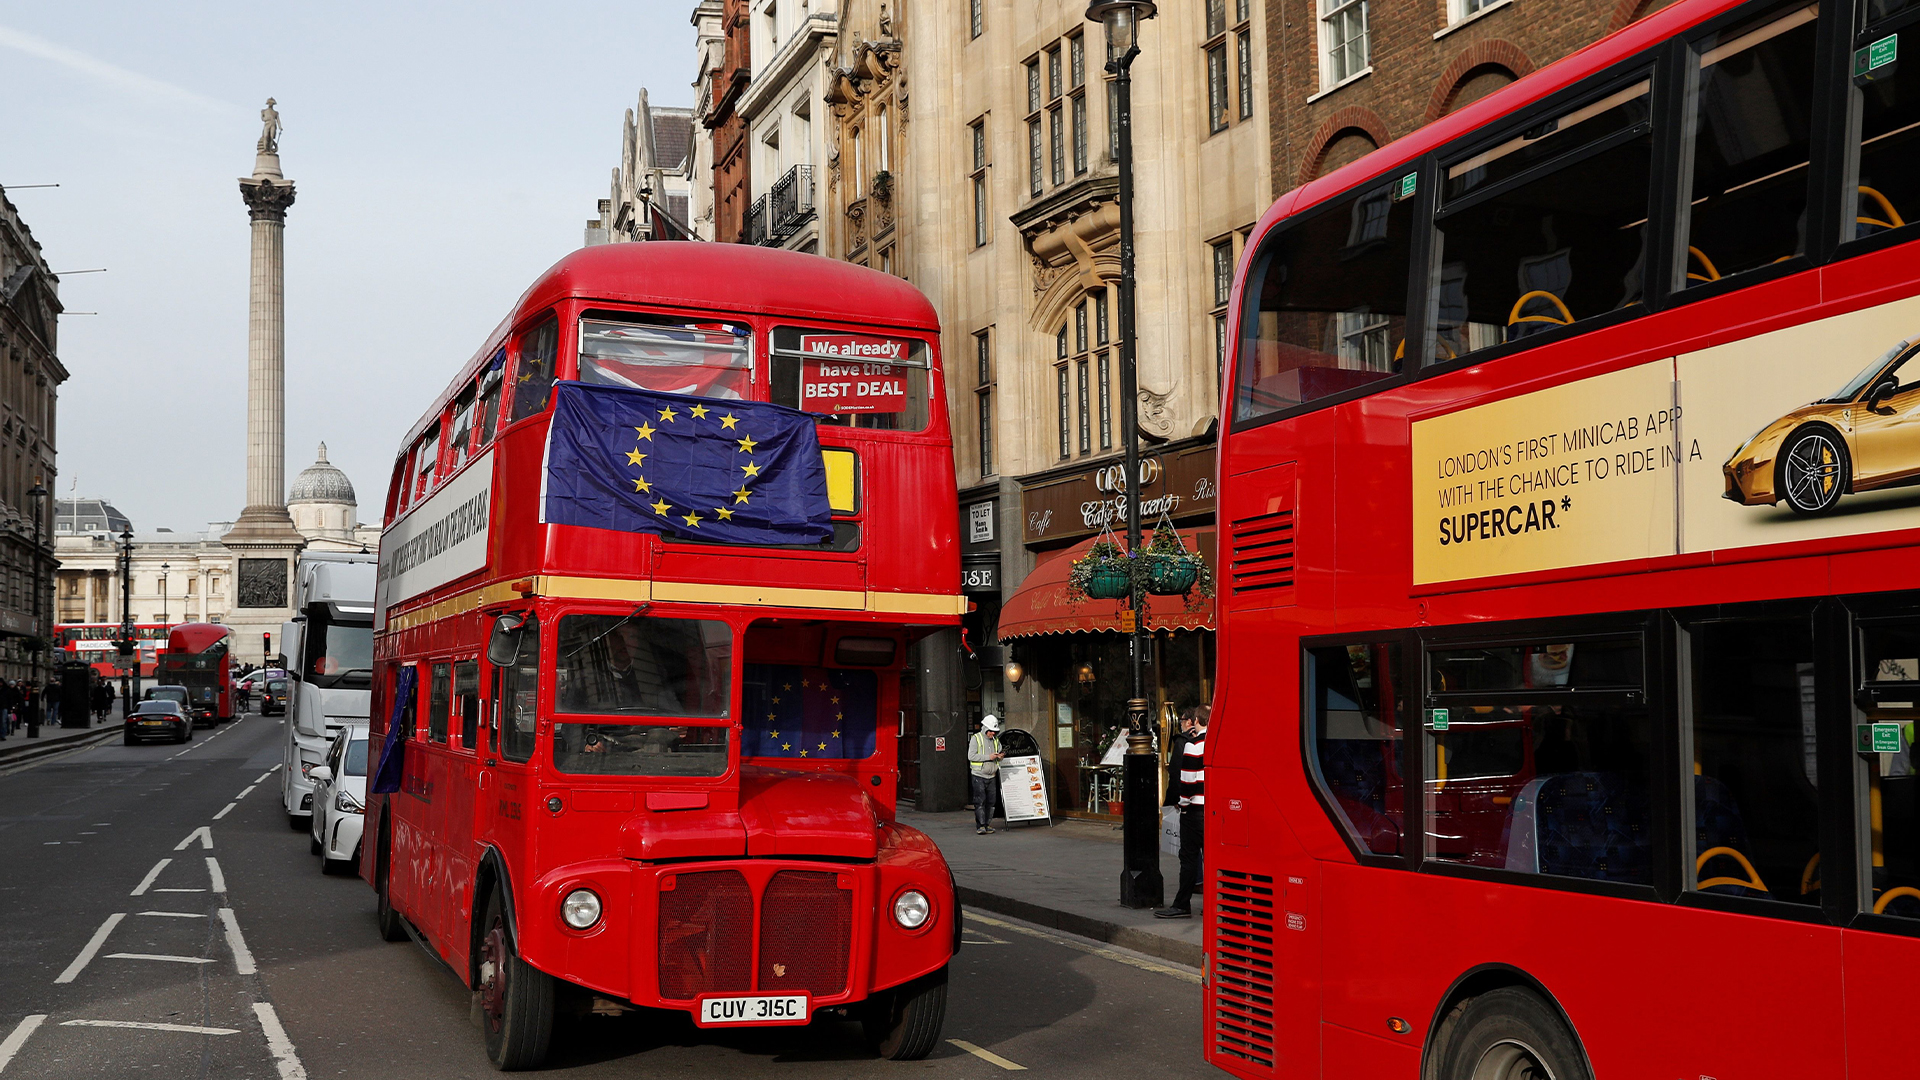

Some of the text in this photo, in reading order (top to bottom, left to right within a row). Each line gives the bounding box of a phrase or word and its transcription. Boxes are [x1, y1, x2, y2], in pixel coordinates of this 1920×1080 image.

[811, 340, 901, 358] We already
[820, 362, 891, 377] have the
[805, 381, 904, 398] BEST DEAL
[1438, 405, 1683, 479] LONDON'S FIRST MINICAB APP
[1096, 458, 1158, 494] GRAD
[1438, 439, 1702, 508] WITH THE CHANCE TO RIDE IN A
[972, 508, 990, 519] TO LET
[711, 999, 797, 1019] CUV 315C
